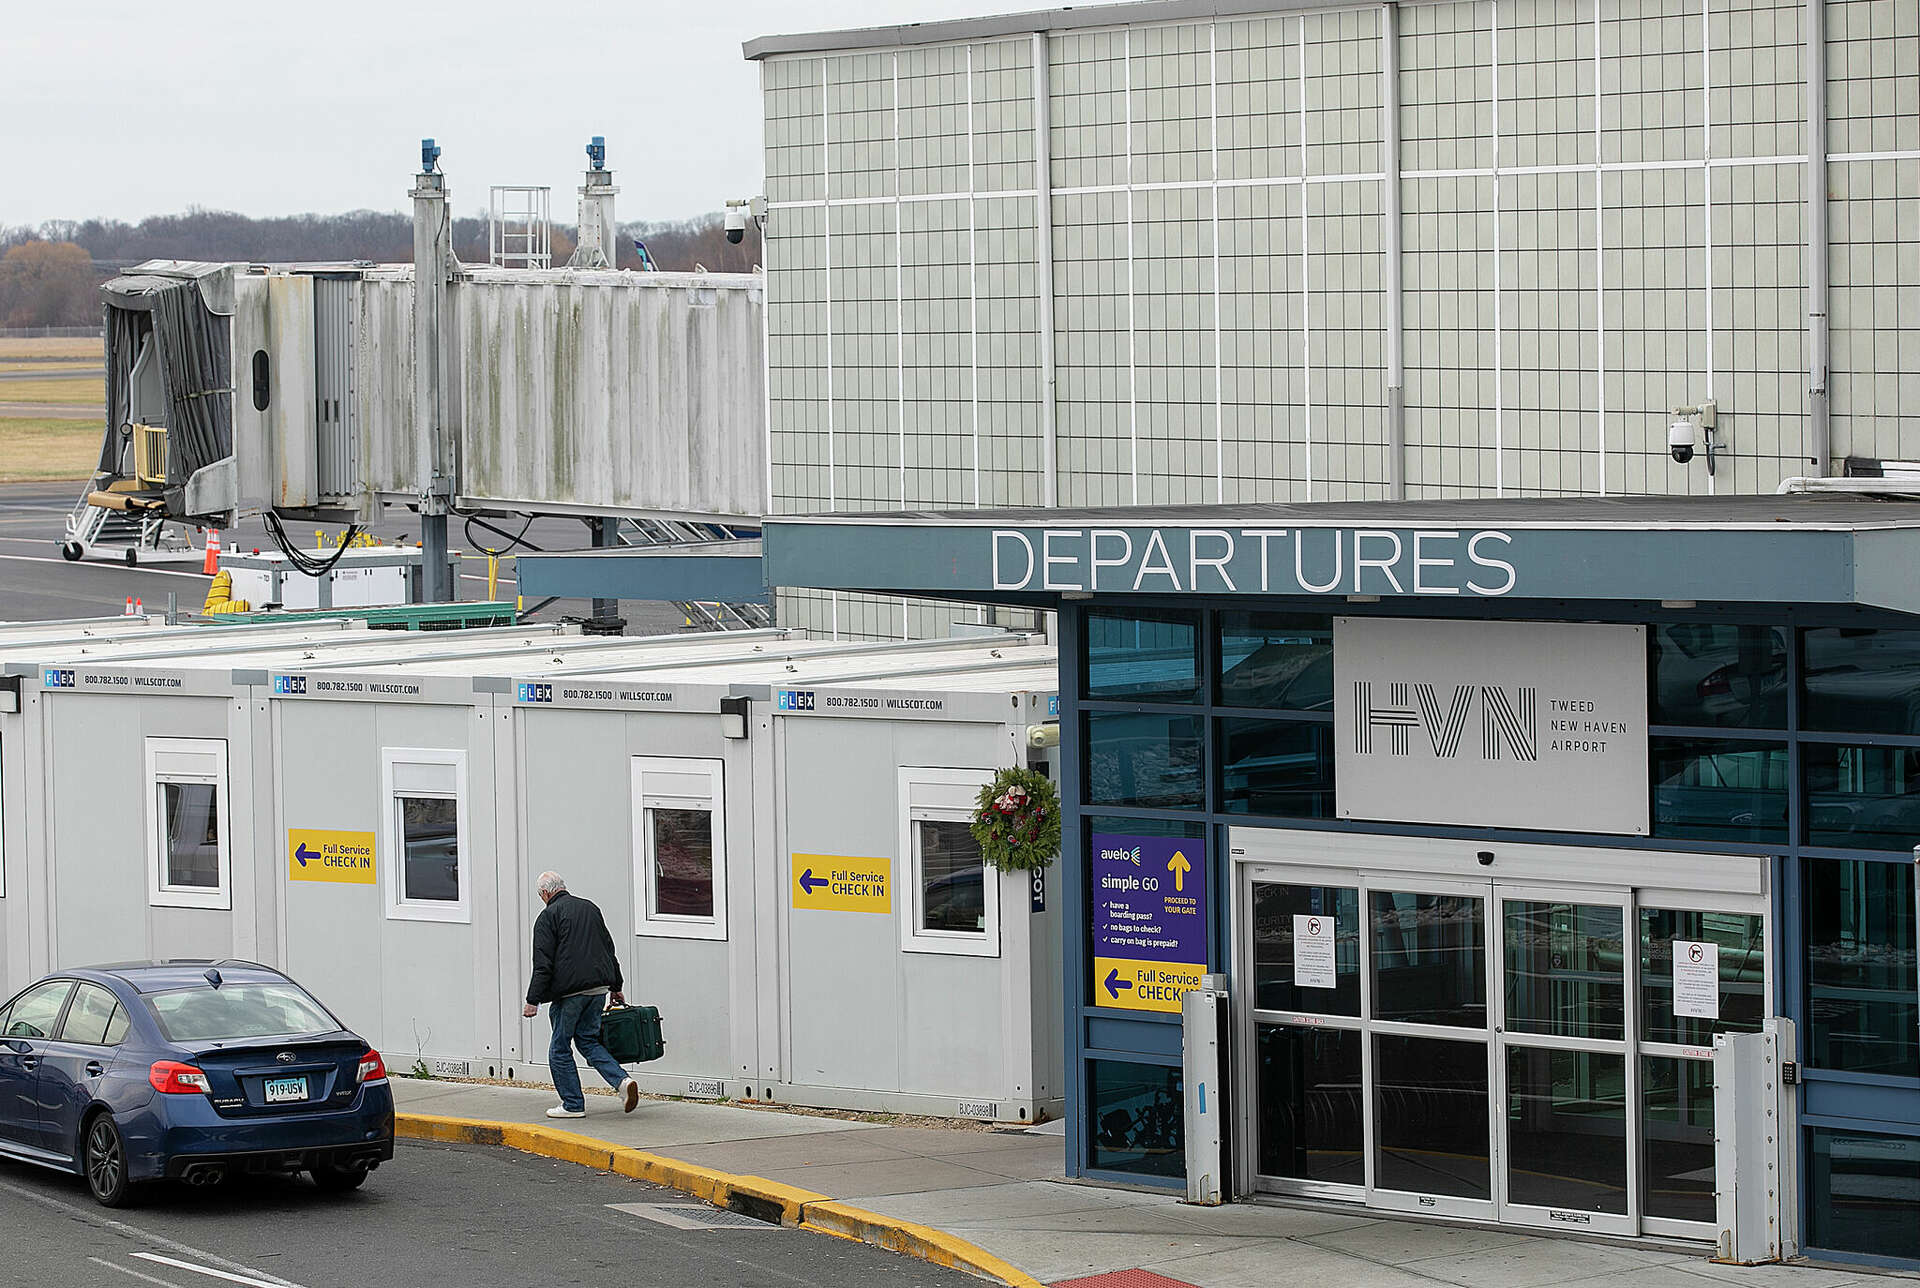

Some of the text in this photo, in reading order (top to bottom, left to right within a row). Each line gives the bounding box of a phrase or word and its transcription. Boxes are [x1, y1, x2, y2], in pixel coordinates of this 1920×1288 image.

[992, 529, 1517, 596] DEPARTURES
[45, 672, 75, 685] FLEX
[84, 675, 182, 687] 800.782.1500 WILLSCOT.COM
[275, 678, 306, 692] FLEX
[317, 681, 419, 694] 800.782.1500 WILLSCOT.COM
[519, 686, 552, 700] FLEX
[563, 689, 672, 702] 800.782.1500 WILLSCOT.COM
[779, 693, 814, 708] FLEX
[826, 697, 943, 710] 800.782.1500 WILLSCOT.COM
[1550, 700, 1594, 712] TWEED
[1354, 682, 1537, 761] HVN
[1551, 720, 1627, 734] NEW HAVEN
[1551, 740, 1607, 753] AIRPORT
[323, 844, 370, 855] Full Service
[1101, 848, 1130, 861] avelo
[324, 856, 370, 868] CHECK IN
[831, 870, 884, 882] Full Service
[1101, 873, 1159, 893] simple GO
[832, 883, 884, 897] CHECK IN
[1109, 901, 1124, 910] have
[1164, 896, 1197, 905] PROCEED TO
[1110, 911, 1153, 921] boarding pass?
[1164, 906, 1197, 915] YOUR GATE
[1119, 923, 1132, 933] bags
[1133, 924, 1140, 932] to
[1140, 925, 1162, 934] check?
[1110, 937, 1126, 946] carry
[1135, 937, 1146, 947] bag
[1147, 938, 1153, 946] is
[1153, 939, 1179, 949] prepaid?
[1137, 970, 1199, 985] Full Service
[1138, 985, 1182, 1002] CHECK
